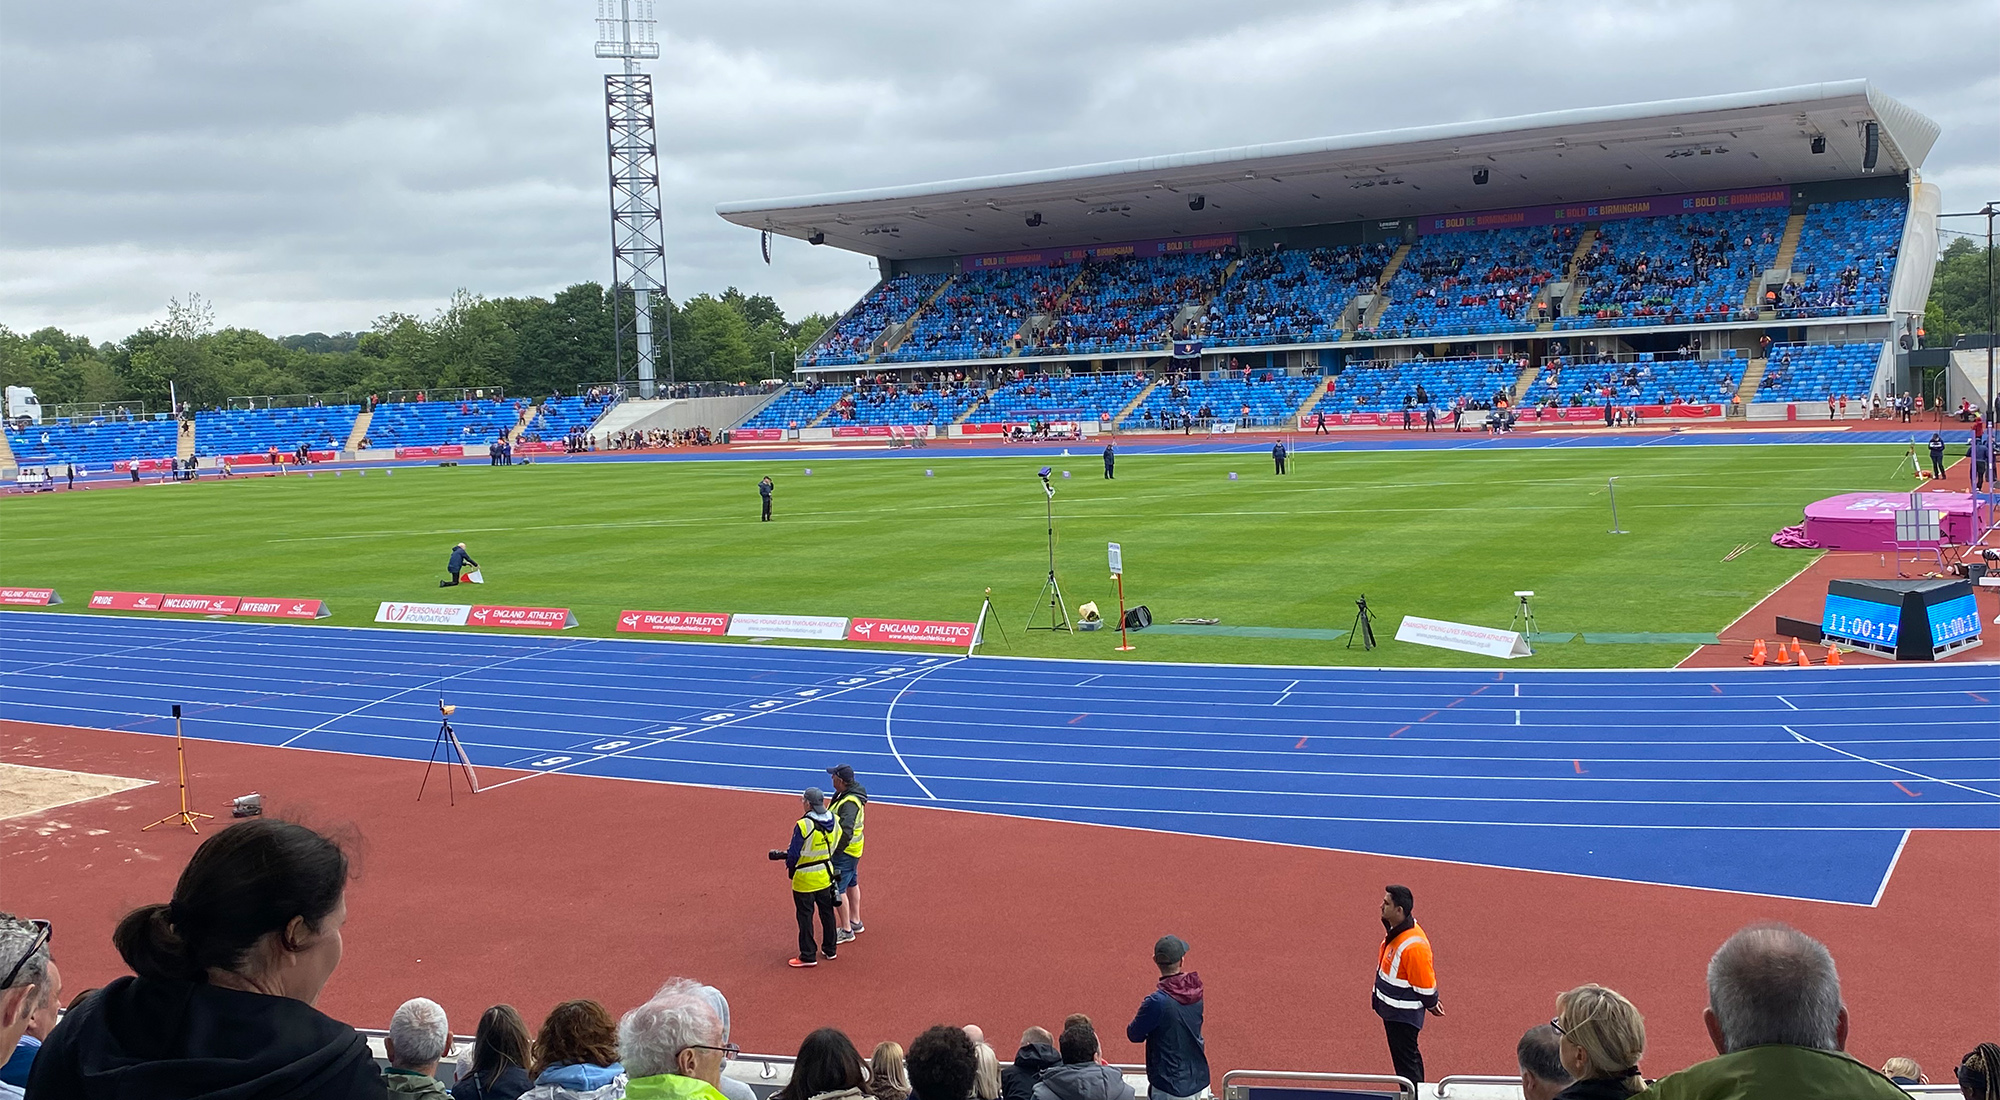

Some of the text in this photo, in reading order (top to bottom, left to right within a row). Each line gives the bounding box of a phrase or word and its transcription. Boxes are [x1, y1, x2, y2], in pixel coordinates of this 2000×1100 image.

[1683, 192, 1784, 208] BE BOLD BE BIRMINGHAM
[1555, 202, 1650, 218] BE BOLD BE BIRMINGHAM
[1435, 213, 1524, 228] BE BOLD BE BIRMINGHAM
[1158, 243, 1166, 251] BE
[1166, 242, 1182, 250] BOLD
[1184, 241, 1192, 249] BE
[1064, 251, 1071, 259] BE
[1096, 246, 1134, 256] BIRMINGHAM
[976, 258, 982, 266] BE
[983, 258, 998, 266] BOLD
[92, 596, 114, 604] PRIDE
[164, 599, 210, 609] INCLUSIVITY
[241, 603, 280, 612] INTEGRITY
[408, 606, 460, 616] PERSONAL BEST
[405, 614, 450, 622] FOUNDATION
[493, 610, 564, 620] ENGLAND ATHLETICS
[644, 616, 724, 626] ENGLAND ATHLETICS
[879, 624, 970, 636] ENGLAND ATHLETICS
[1830, 614, 1898, 642] 11:00:17
[1936, 612, 1978, 641] 11:00:17
[1403, 621, 1429, 630] CHANGING
[1428, 624, 1446, 633] YOUNG
[1460, 629, 1486, 639] THROUGH
[1486, 632, 1514, 643] ATHLETICS
[888, 634, 956, 643] www.englandathletics.org
[748, 700, 784, 708] 5
[700, 713, 736, 721] 6
[647, 726, 688, 735] 7
[592, 741, 630, 750] 8
[531, 756, 572, 766] 9
